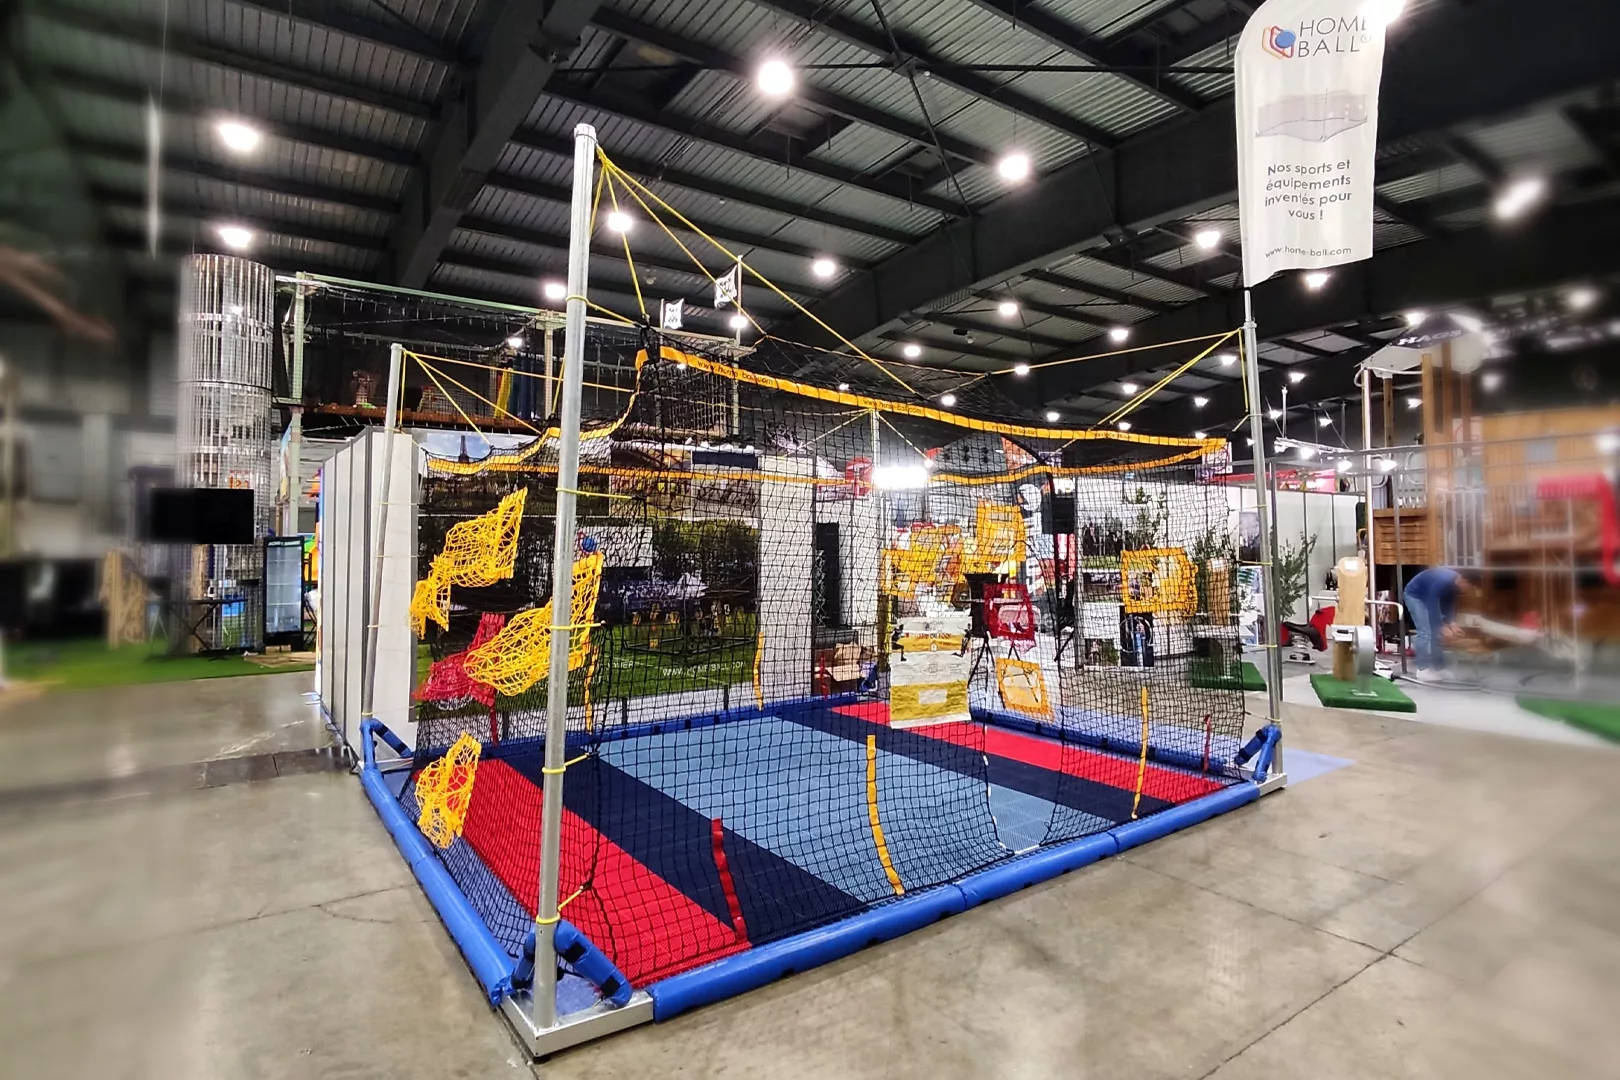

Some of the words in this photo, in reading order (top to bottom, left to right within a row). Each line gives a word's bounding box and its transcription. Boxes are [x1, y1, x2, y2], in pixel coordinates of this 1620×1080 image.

[1298, 36, 1360, 57] BALL
[1267, 164, 1291, 176] Nos
[1294, 162, 1332, 175] sports
[1336, 159, 1351, 170] et
[1266, 175, 1351, 191] équipements
[1319, 191, 1352, 207] pour
[1288, 210, 1315, 220] vous
